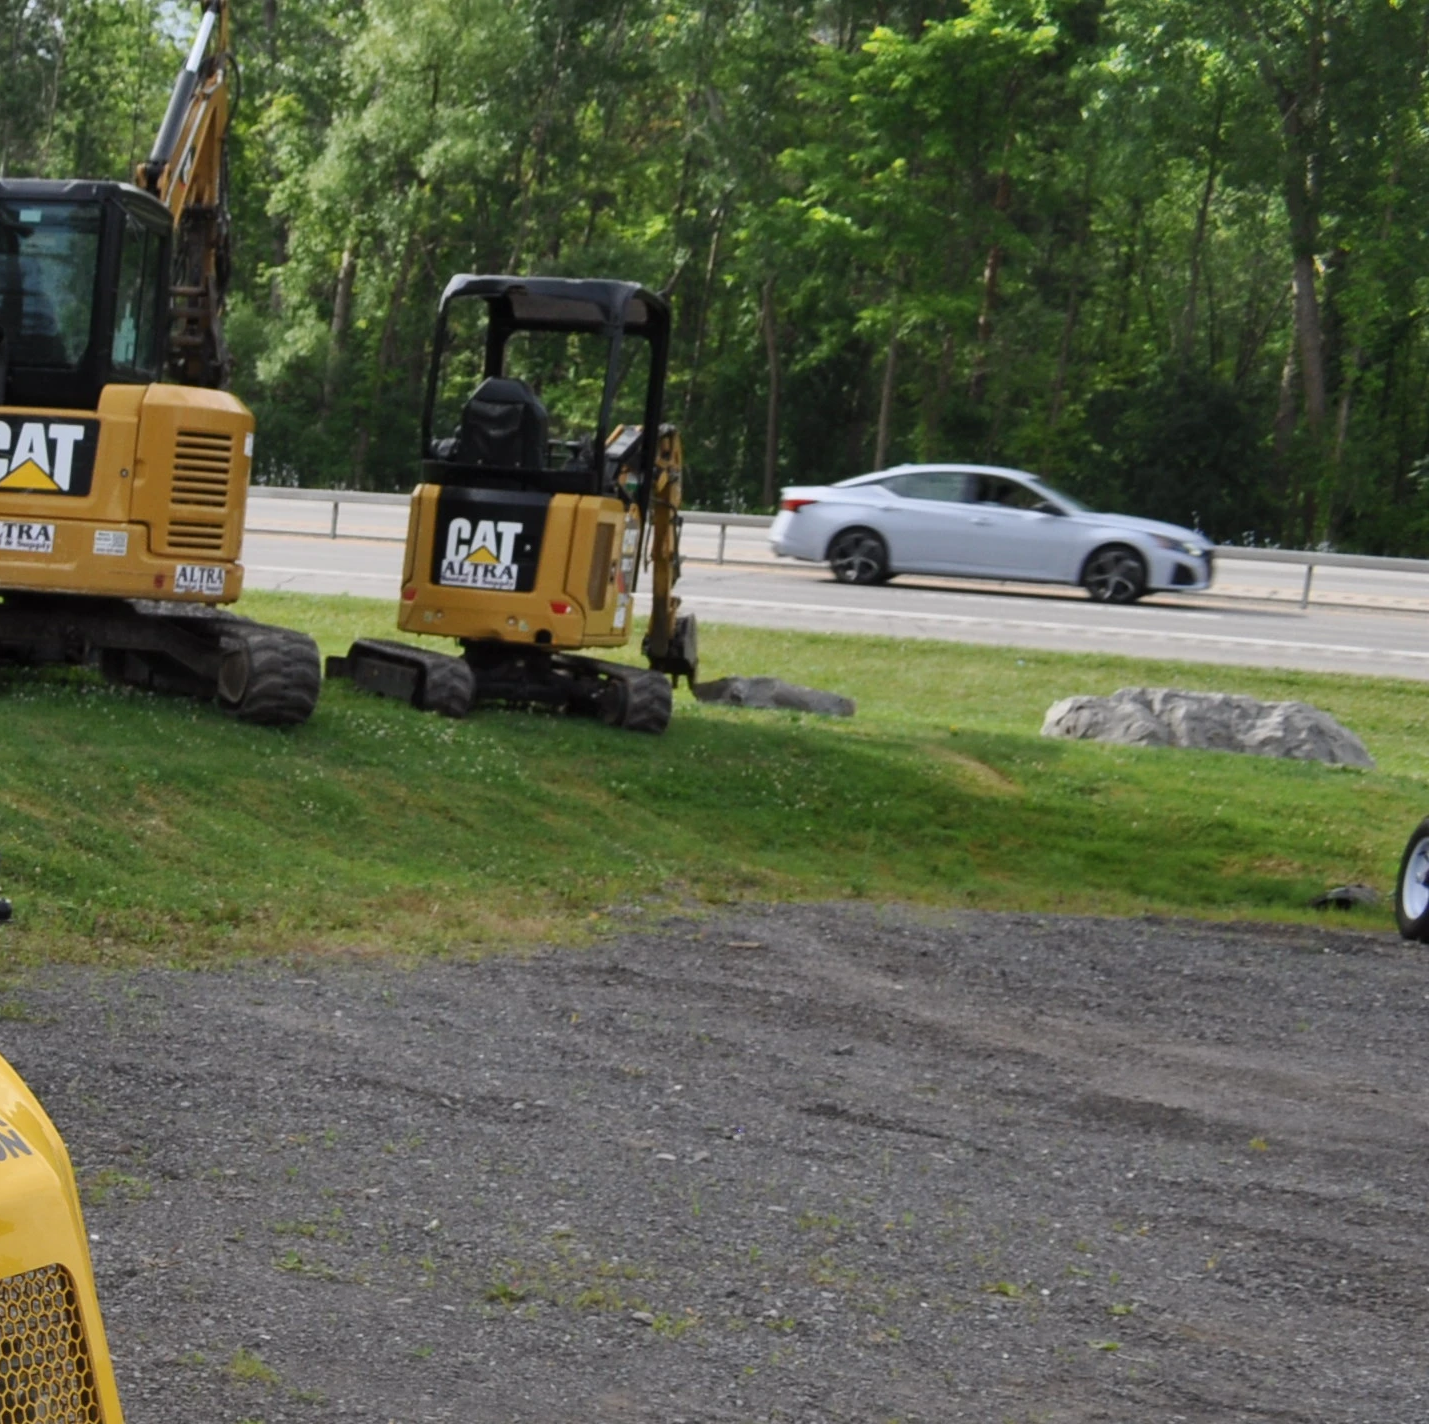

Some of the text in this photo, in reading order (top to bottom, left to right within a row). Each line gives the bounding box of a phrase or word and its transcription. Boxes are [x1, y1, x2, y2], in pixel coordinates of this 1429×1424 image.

[445, 517, 523, 565] CAT
[177, 567, 223, 585] ALTRA
[442, 561, 513, 580] ALTRA
